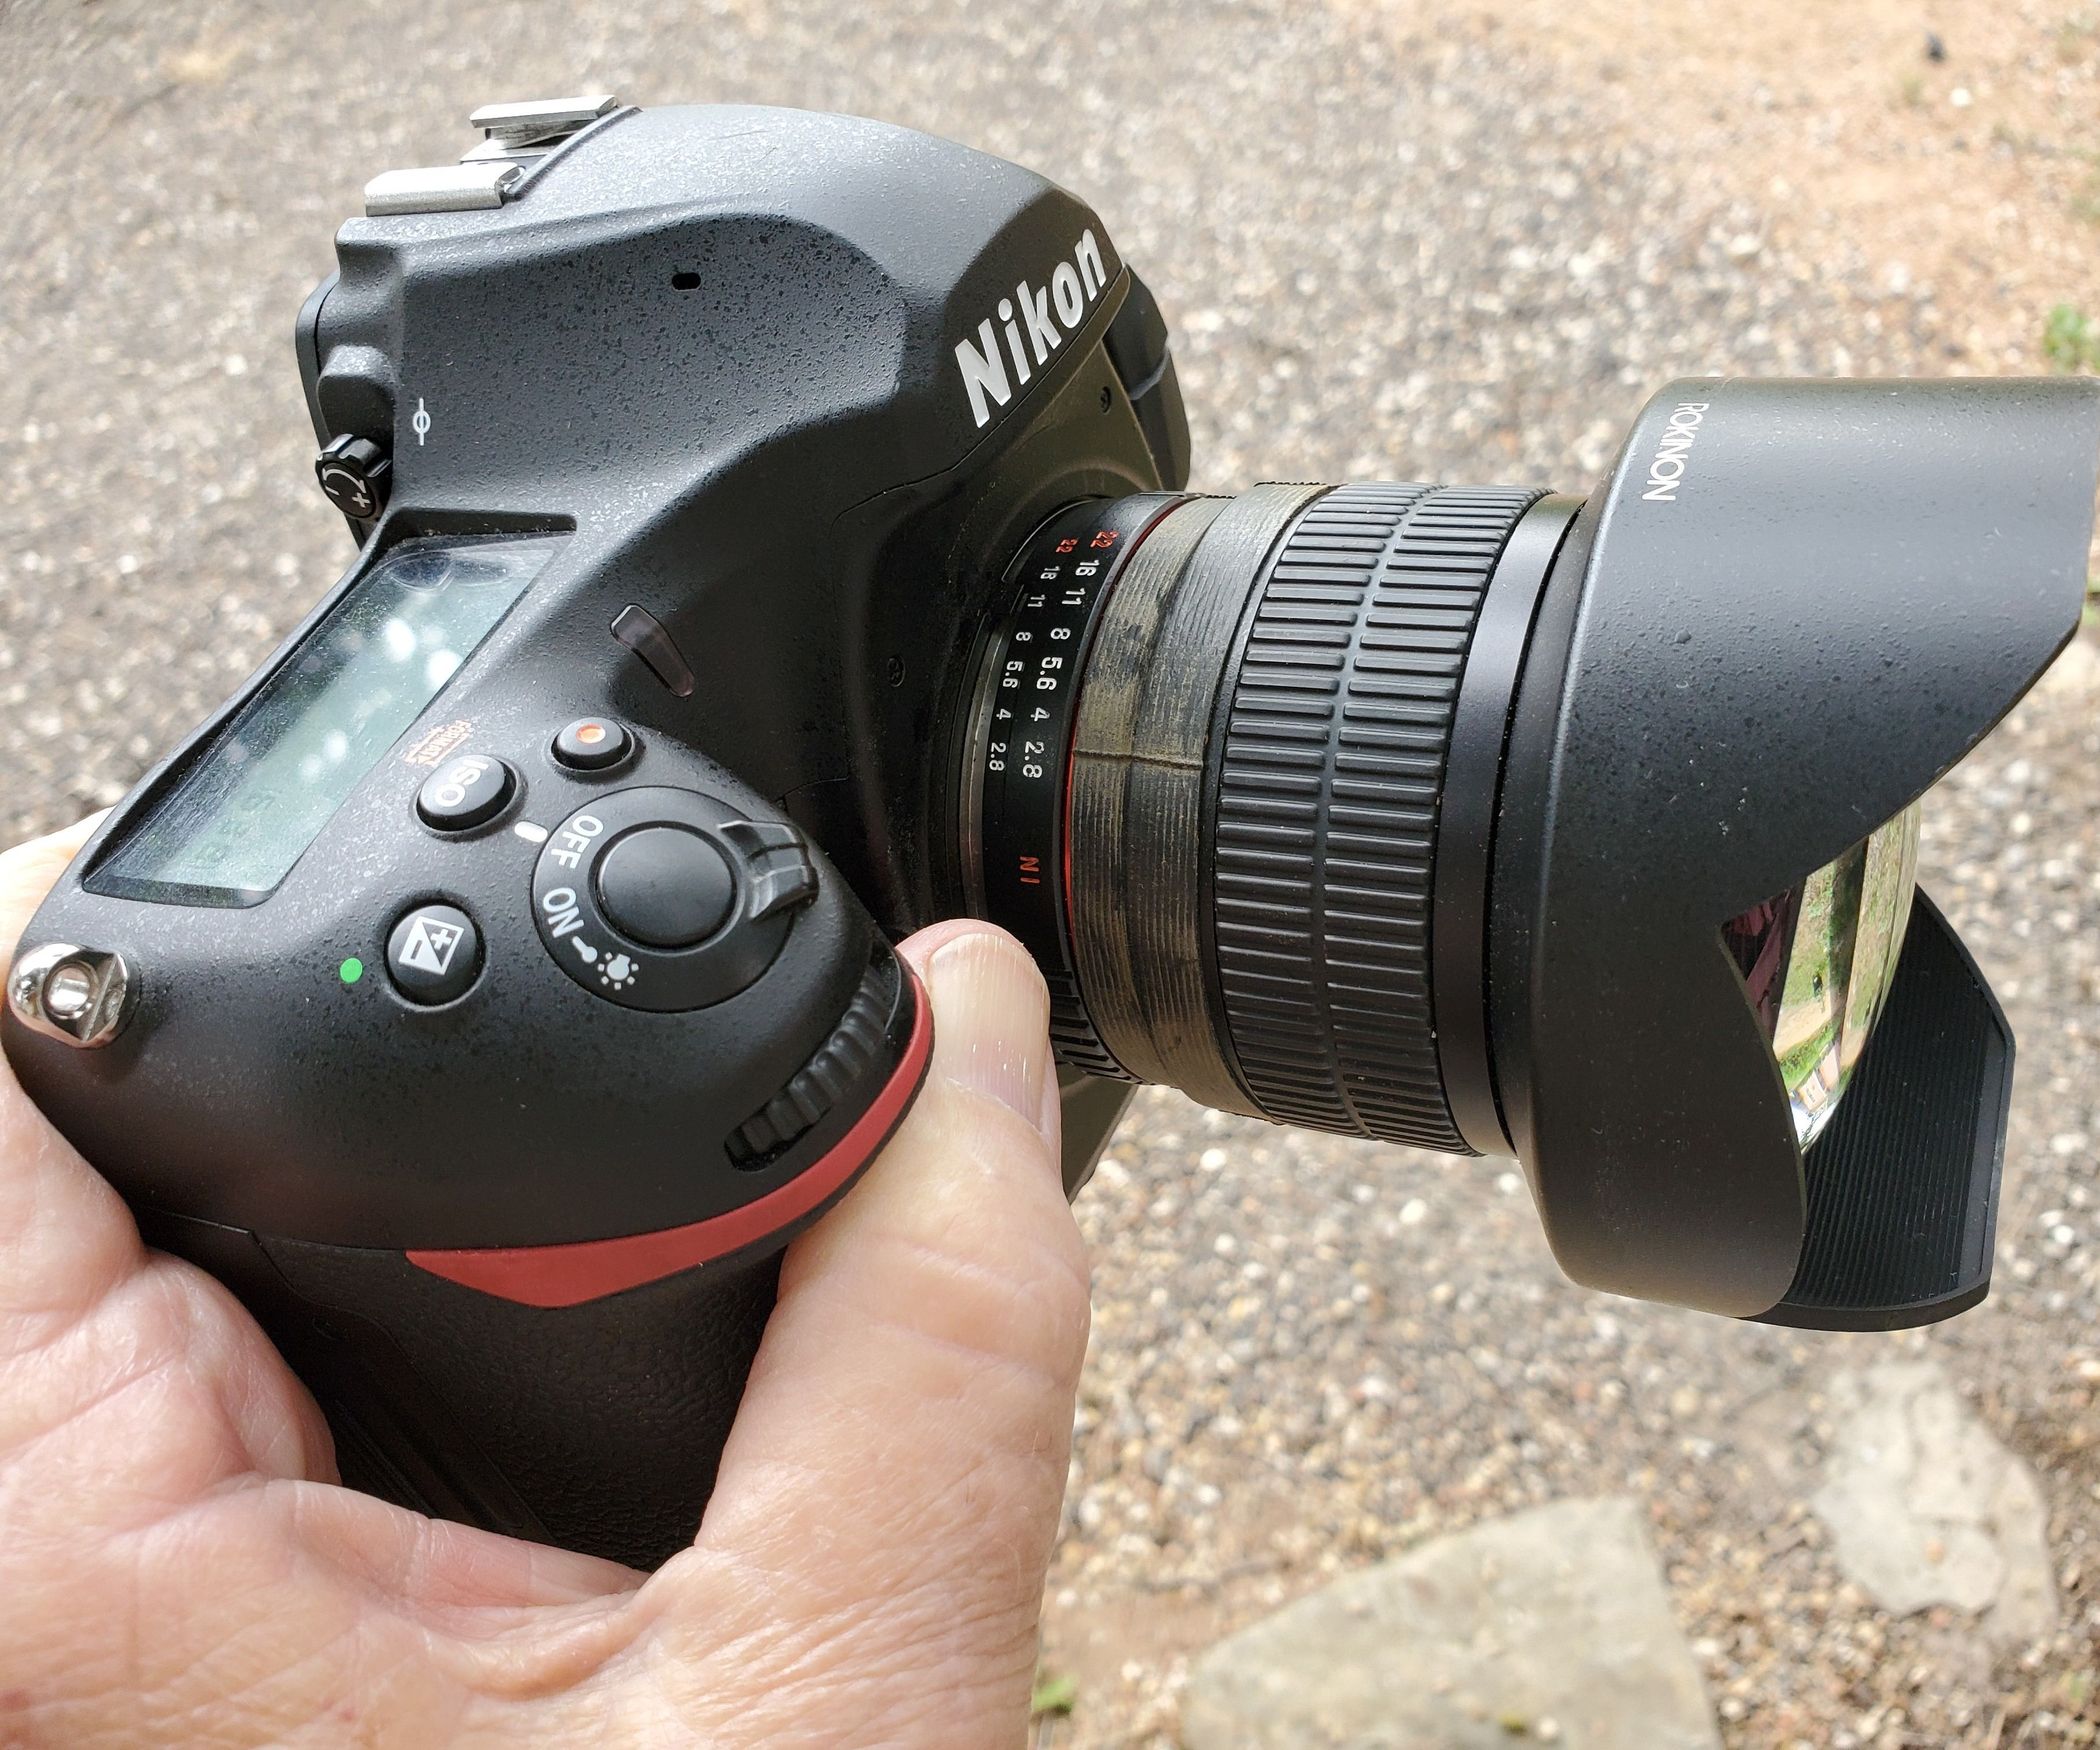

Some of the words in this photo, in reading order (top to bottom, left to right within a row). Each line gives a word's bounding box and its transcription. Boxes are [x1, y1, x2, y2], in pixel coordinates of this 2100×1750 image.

[955, 229, 1107, 428] Nikon
[1642, 402, 1710, 501] ROKINON
[1055, 538, 1079, 554] 22
[1089, 530, 1119, 549] 22
[1075, 559, 1100, 577] 16
[1027, 594, 1046, 608] 11
[1061, 587, 1086, 606] 11
[1015, 631, 1033, 642] 8
[1050, 627, 1071, 641] 8
[1002, 660, 1024, 689] 5.6
[1036, 656, 1063, 691] 5.6
[996, 708, 1012, 720] 4
[1030, 707, 1051, 722] 4
[988, 742, 1007, 772] 2.8
[1022, 741, 1045, 780] 2.8
[434, 759, 489, 807] ISO
[550, 815, 604, 869] OFF
[543, 887, 585, 938] ON
